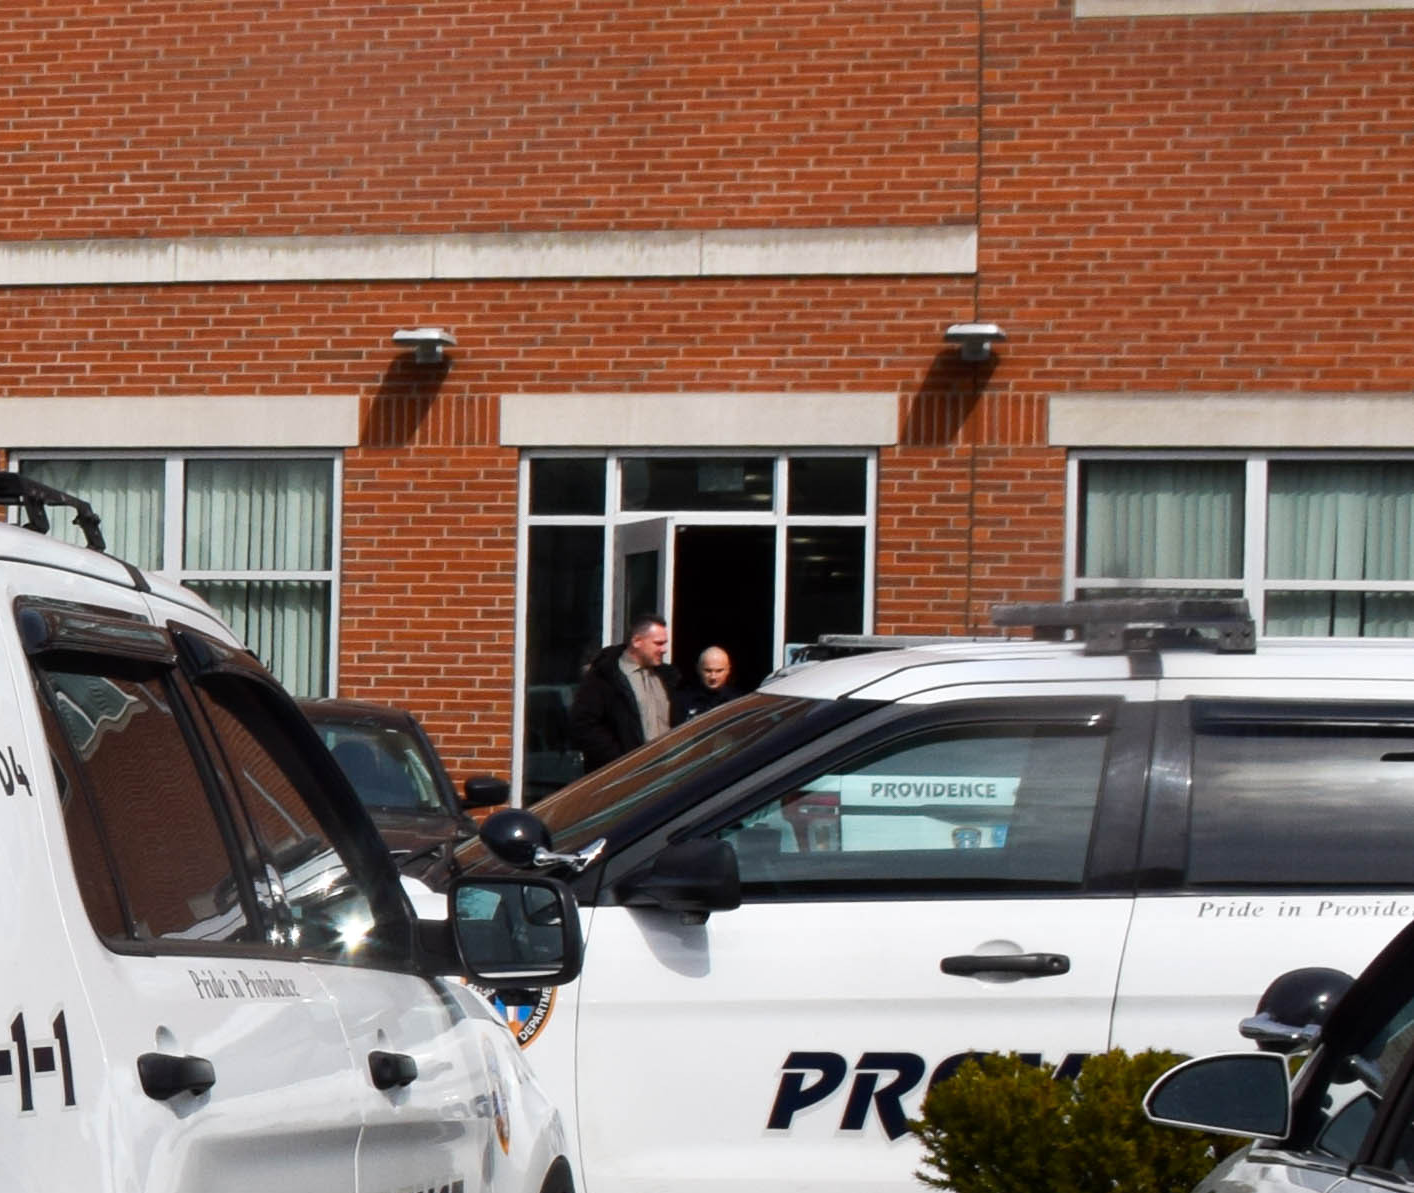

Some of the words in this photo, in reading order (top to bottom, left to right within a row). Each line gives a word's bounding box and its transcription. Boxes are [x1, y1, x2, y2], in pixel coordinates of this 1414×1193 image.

[872, 782, 997, 798] PROVIDENCE
[1197, 902, 1264, 917] Pride
[1278, 902, 1301, 916] in
[1317, 901, 1414, 916] Provide
[188, 969, 229, 999] Pride
